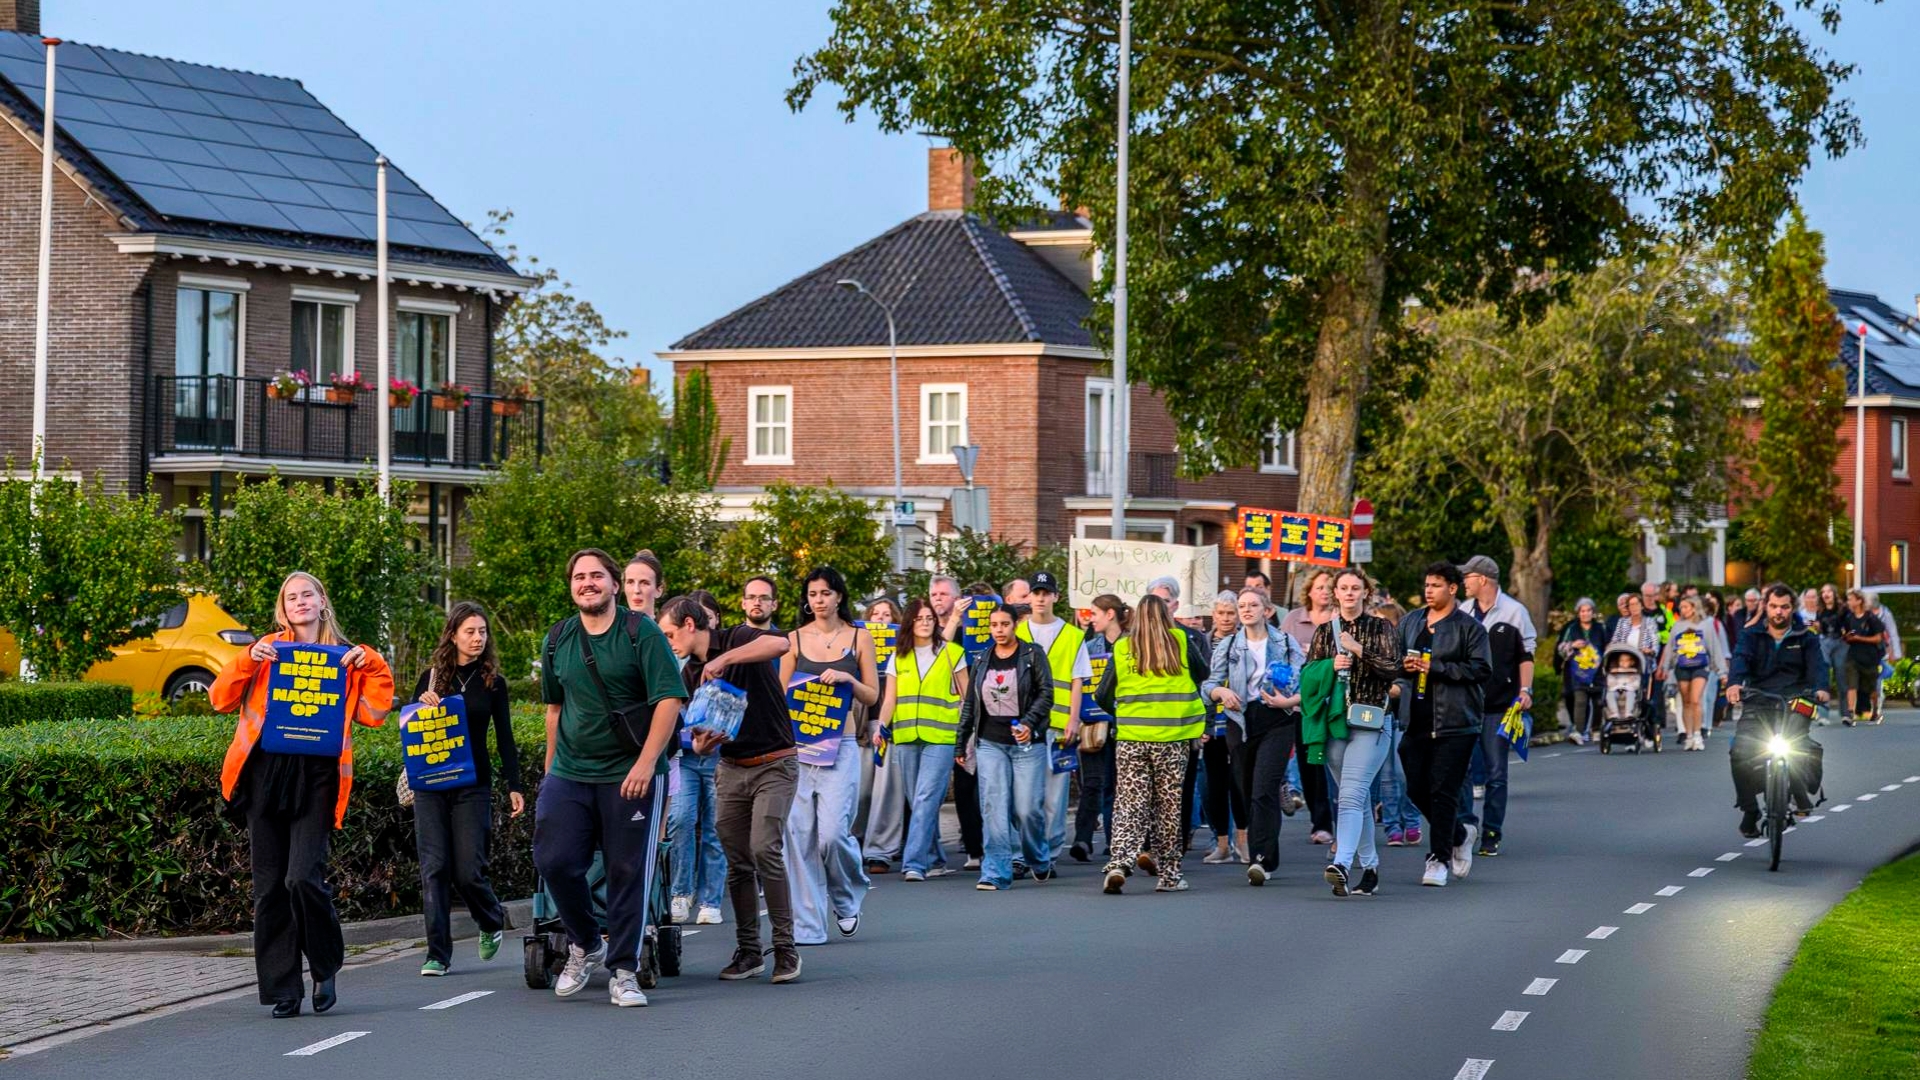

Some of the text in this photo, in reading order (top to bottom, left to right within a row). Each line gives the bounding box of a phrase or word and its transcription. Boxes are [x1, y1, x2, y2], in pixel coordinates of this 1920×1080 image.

[1080, 568, 1108, 596] de
[293, 650, 328, 665] WIJ
[279, 662, 338, 680] EISEN
[293, 677, 321, 691] DE
[805, 681, 835, 696] WIJ
[272, 688, 340, 706] NACHT
[792, 689, 843, 709] EISEN
[290, 703, 320, 717] OP
[416, 705, 447, 719] WIJ
[803, 702, 828, 716] DE
[407, 714, 459, 733] EISEN
[788, 708, 842, 731] NACHT
[422, 728, 447, 743] DE
[799, 722, 823, 737] OP
[406, 735, 465, 757] NACHT
[425, 750, 451, 765] OP
